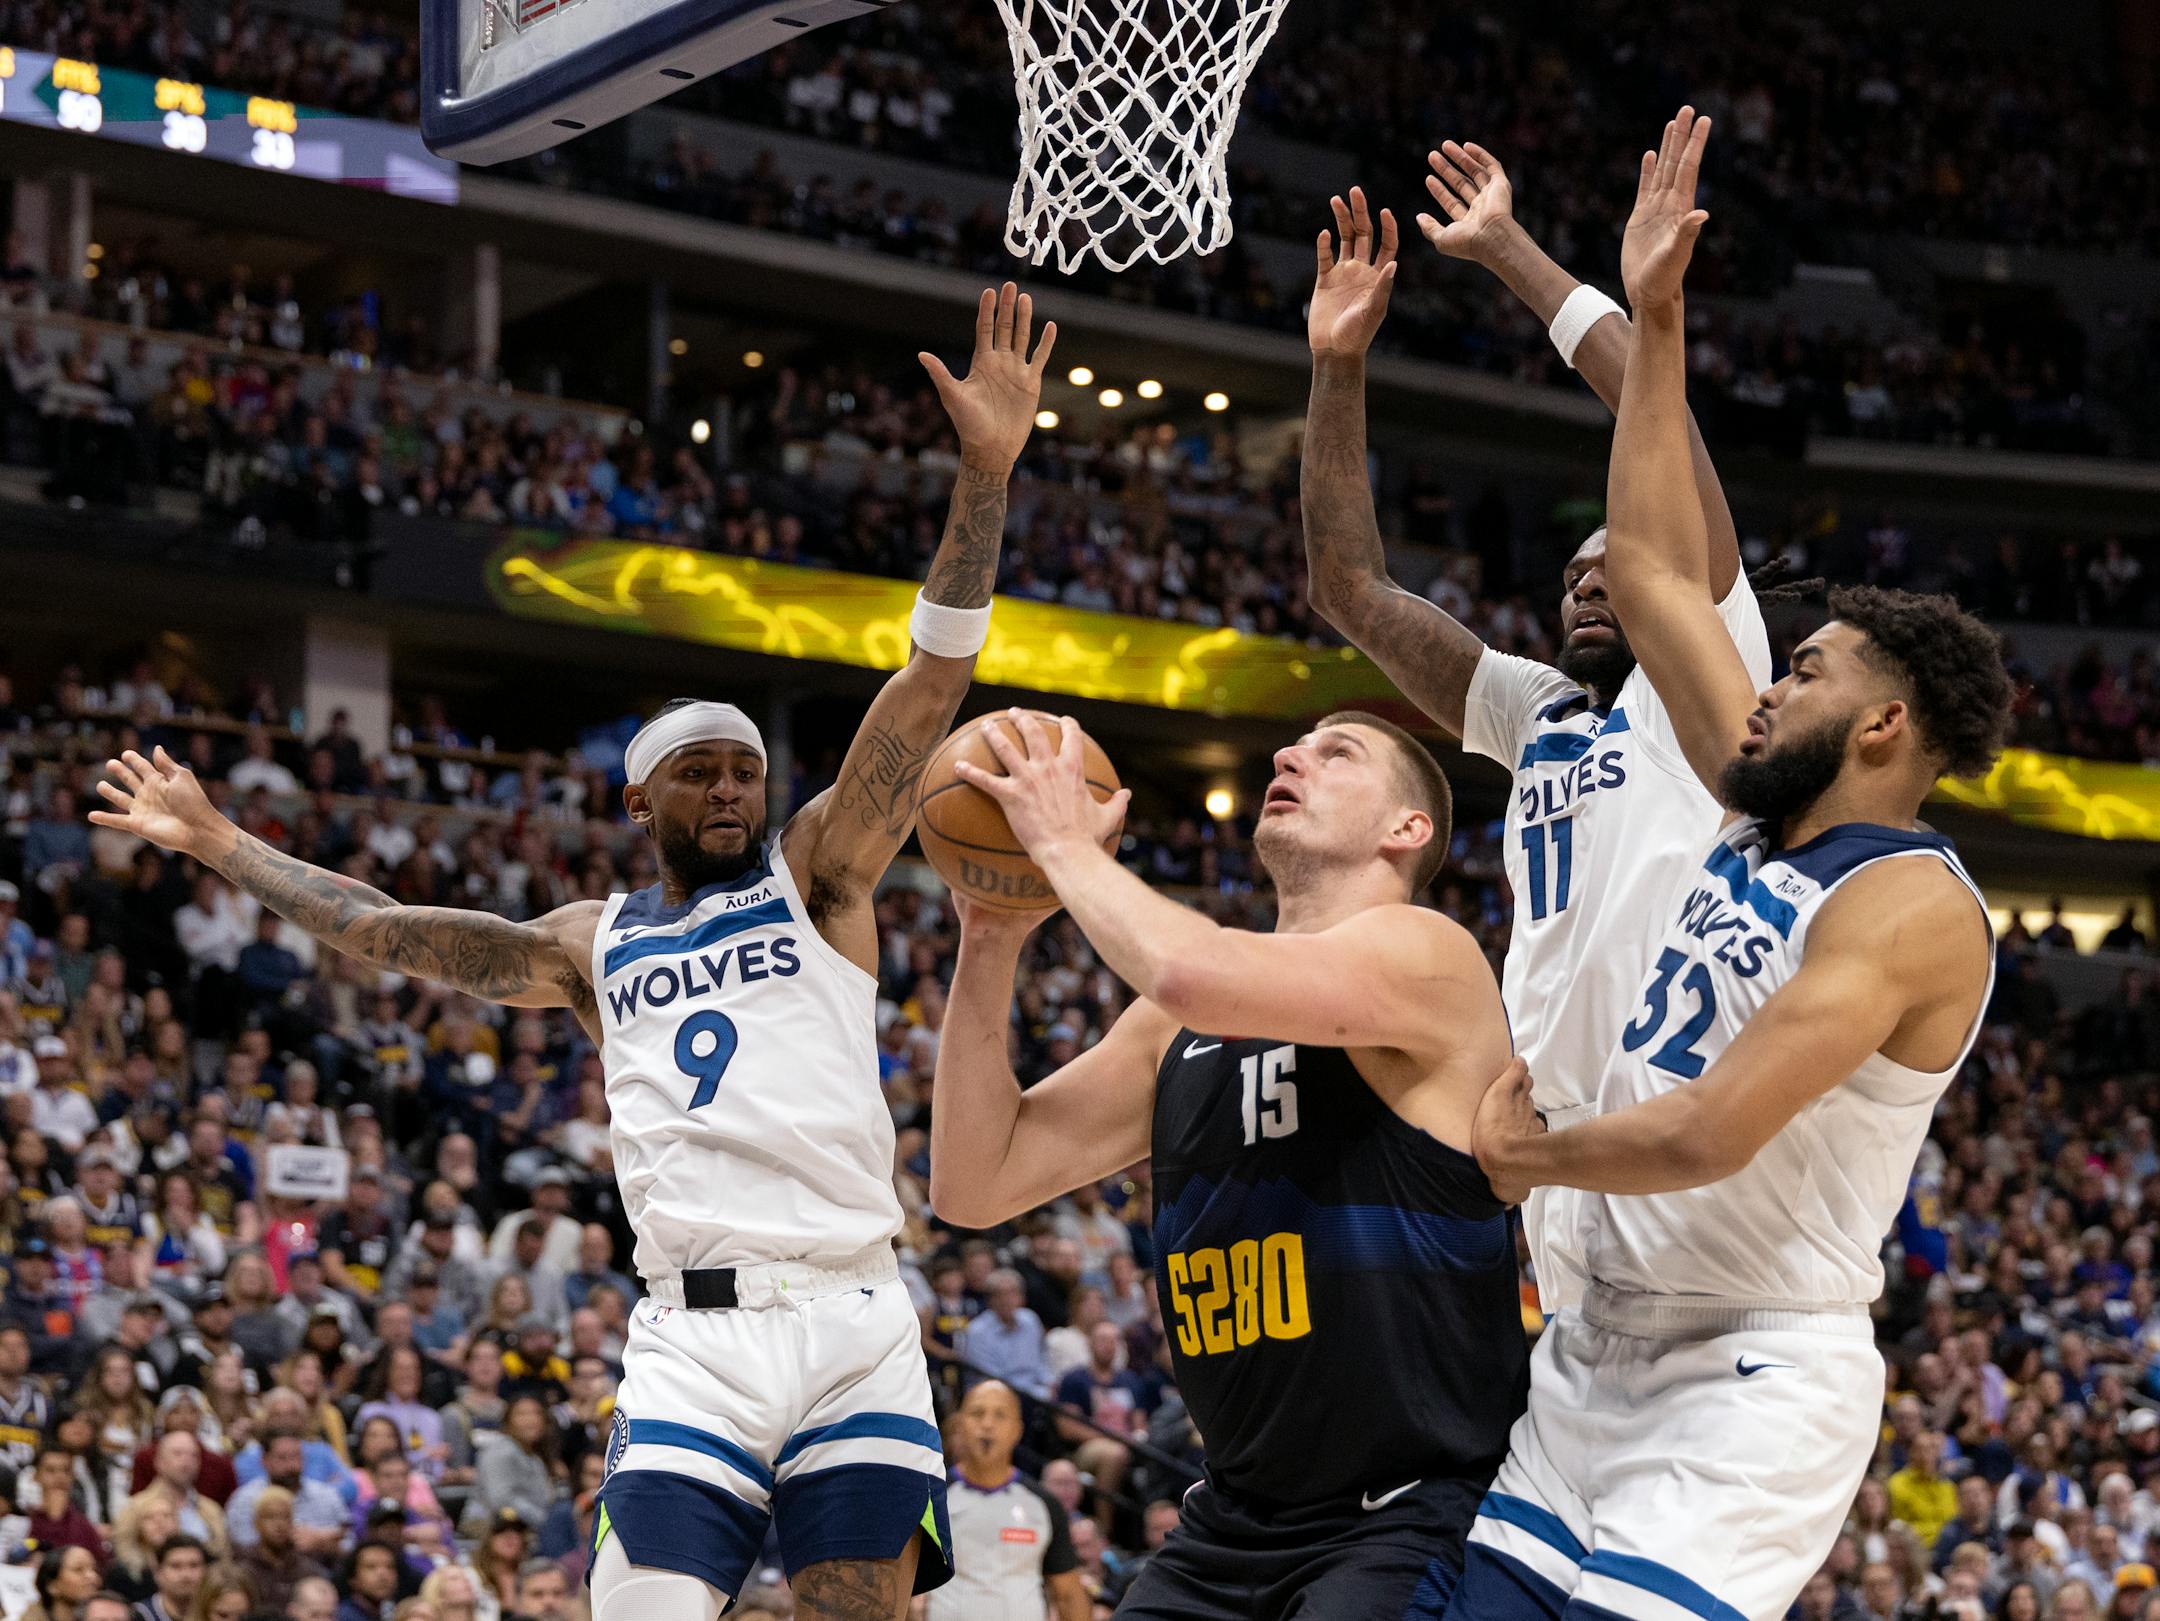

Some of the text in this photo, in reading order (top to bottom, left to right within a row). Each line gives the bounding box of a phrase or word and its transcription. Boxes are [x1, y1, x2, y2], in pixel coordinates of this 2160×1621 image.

[1520, 750, 1626, 822] OLVES
[1520, 815, 1573, 921] 11
[607, 937, 801, 1026] WOLVES
[1622, 945, 1717, 1079] 32
[673, 1009, 739, 1112] 9
[1240, 1043, 1299, 1146] 15
[1167, 1232, 1312, 1357] 5280
